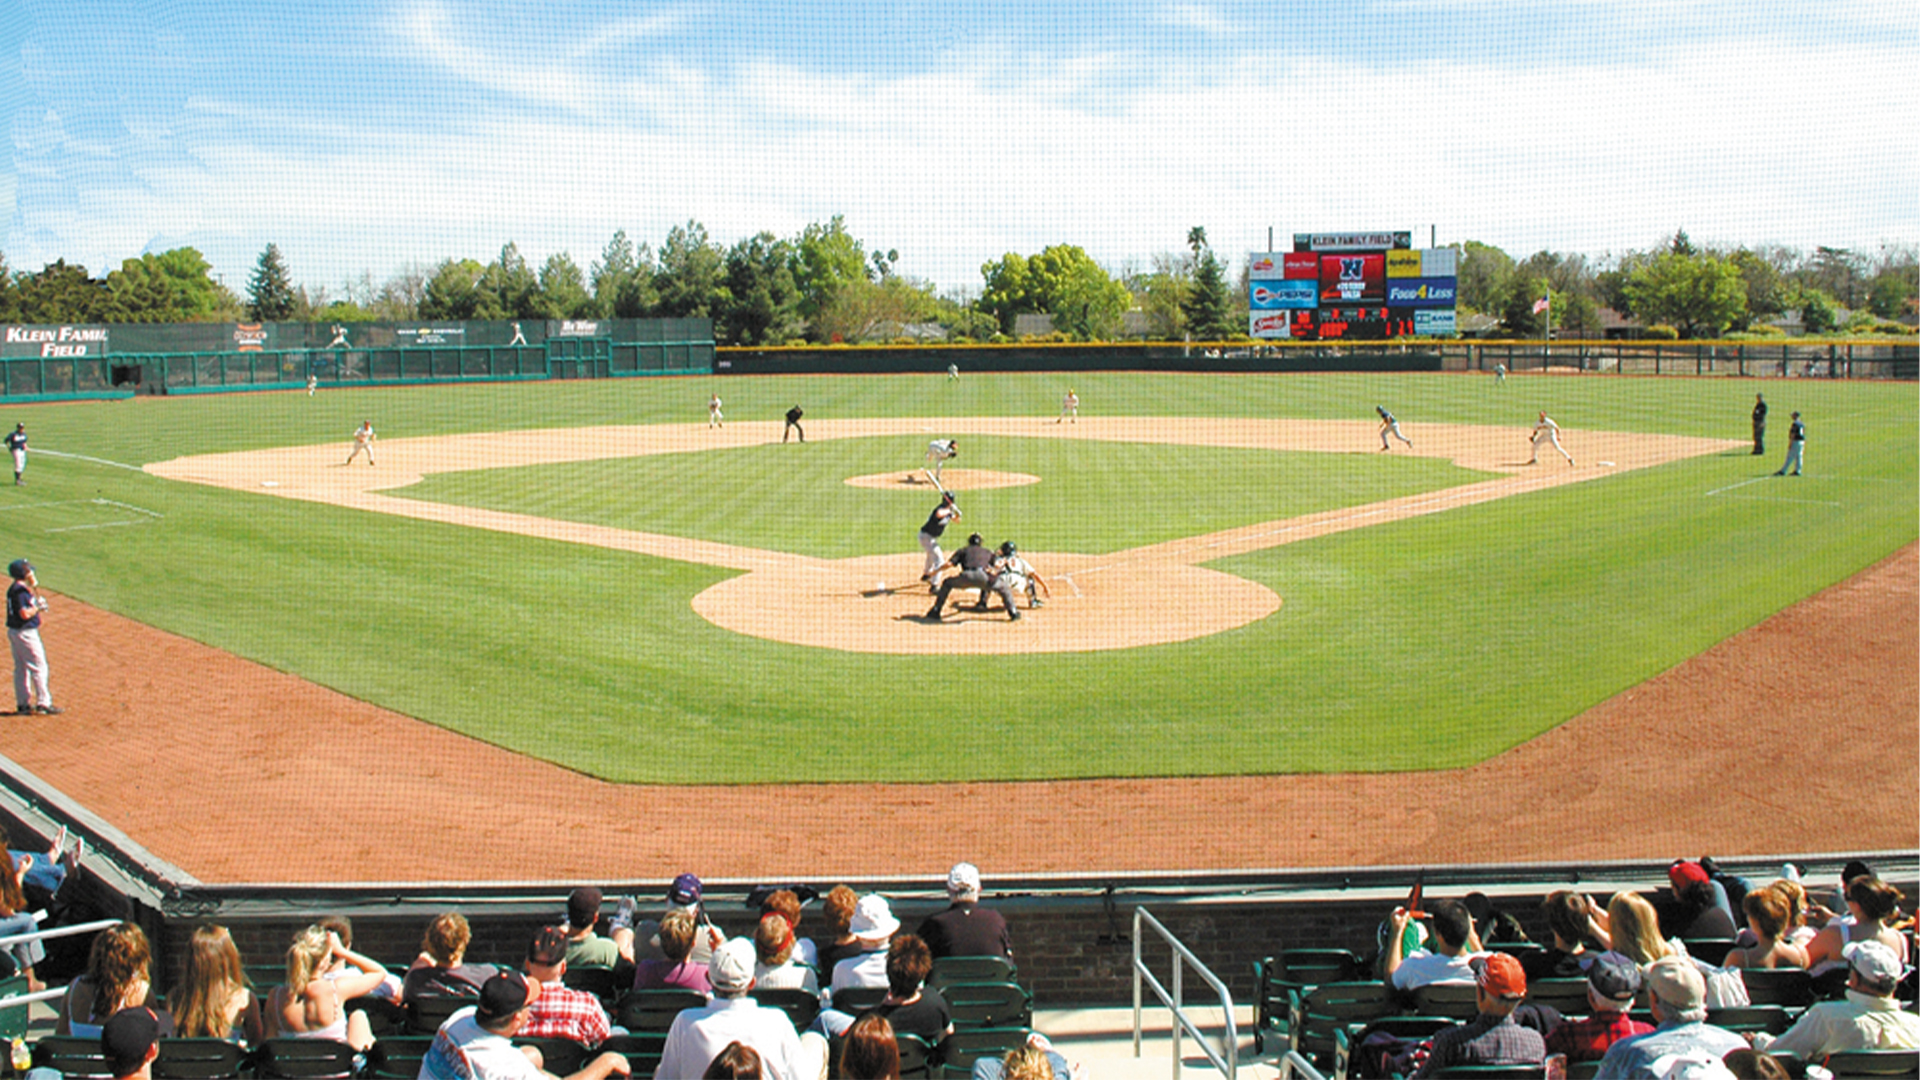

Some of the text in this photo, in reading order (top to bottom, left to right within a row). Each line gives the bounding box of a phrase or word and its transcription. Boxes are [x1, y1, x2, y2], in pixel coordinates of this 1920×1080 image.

[1312, 234, 1392, 246] KLEIN FAMILY FIELD
[1340, 258, 1365, 280] N
[1417, 284, 1427, 299] 4
[6, 327, 56, 342] KLEIN
[41, 343, 86, 357] FIELD
